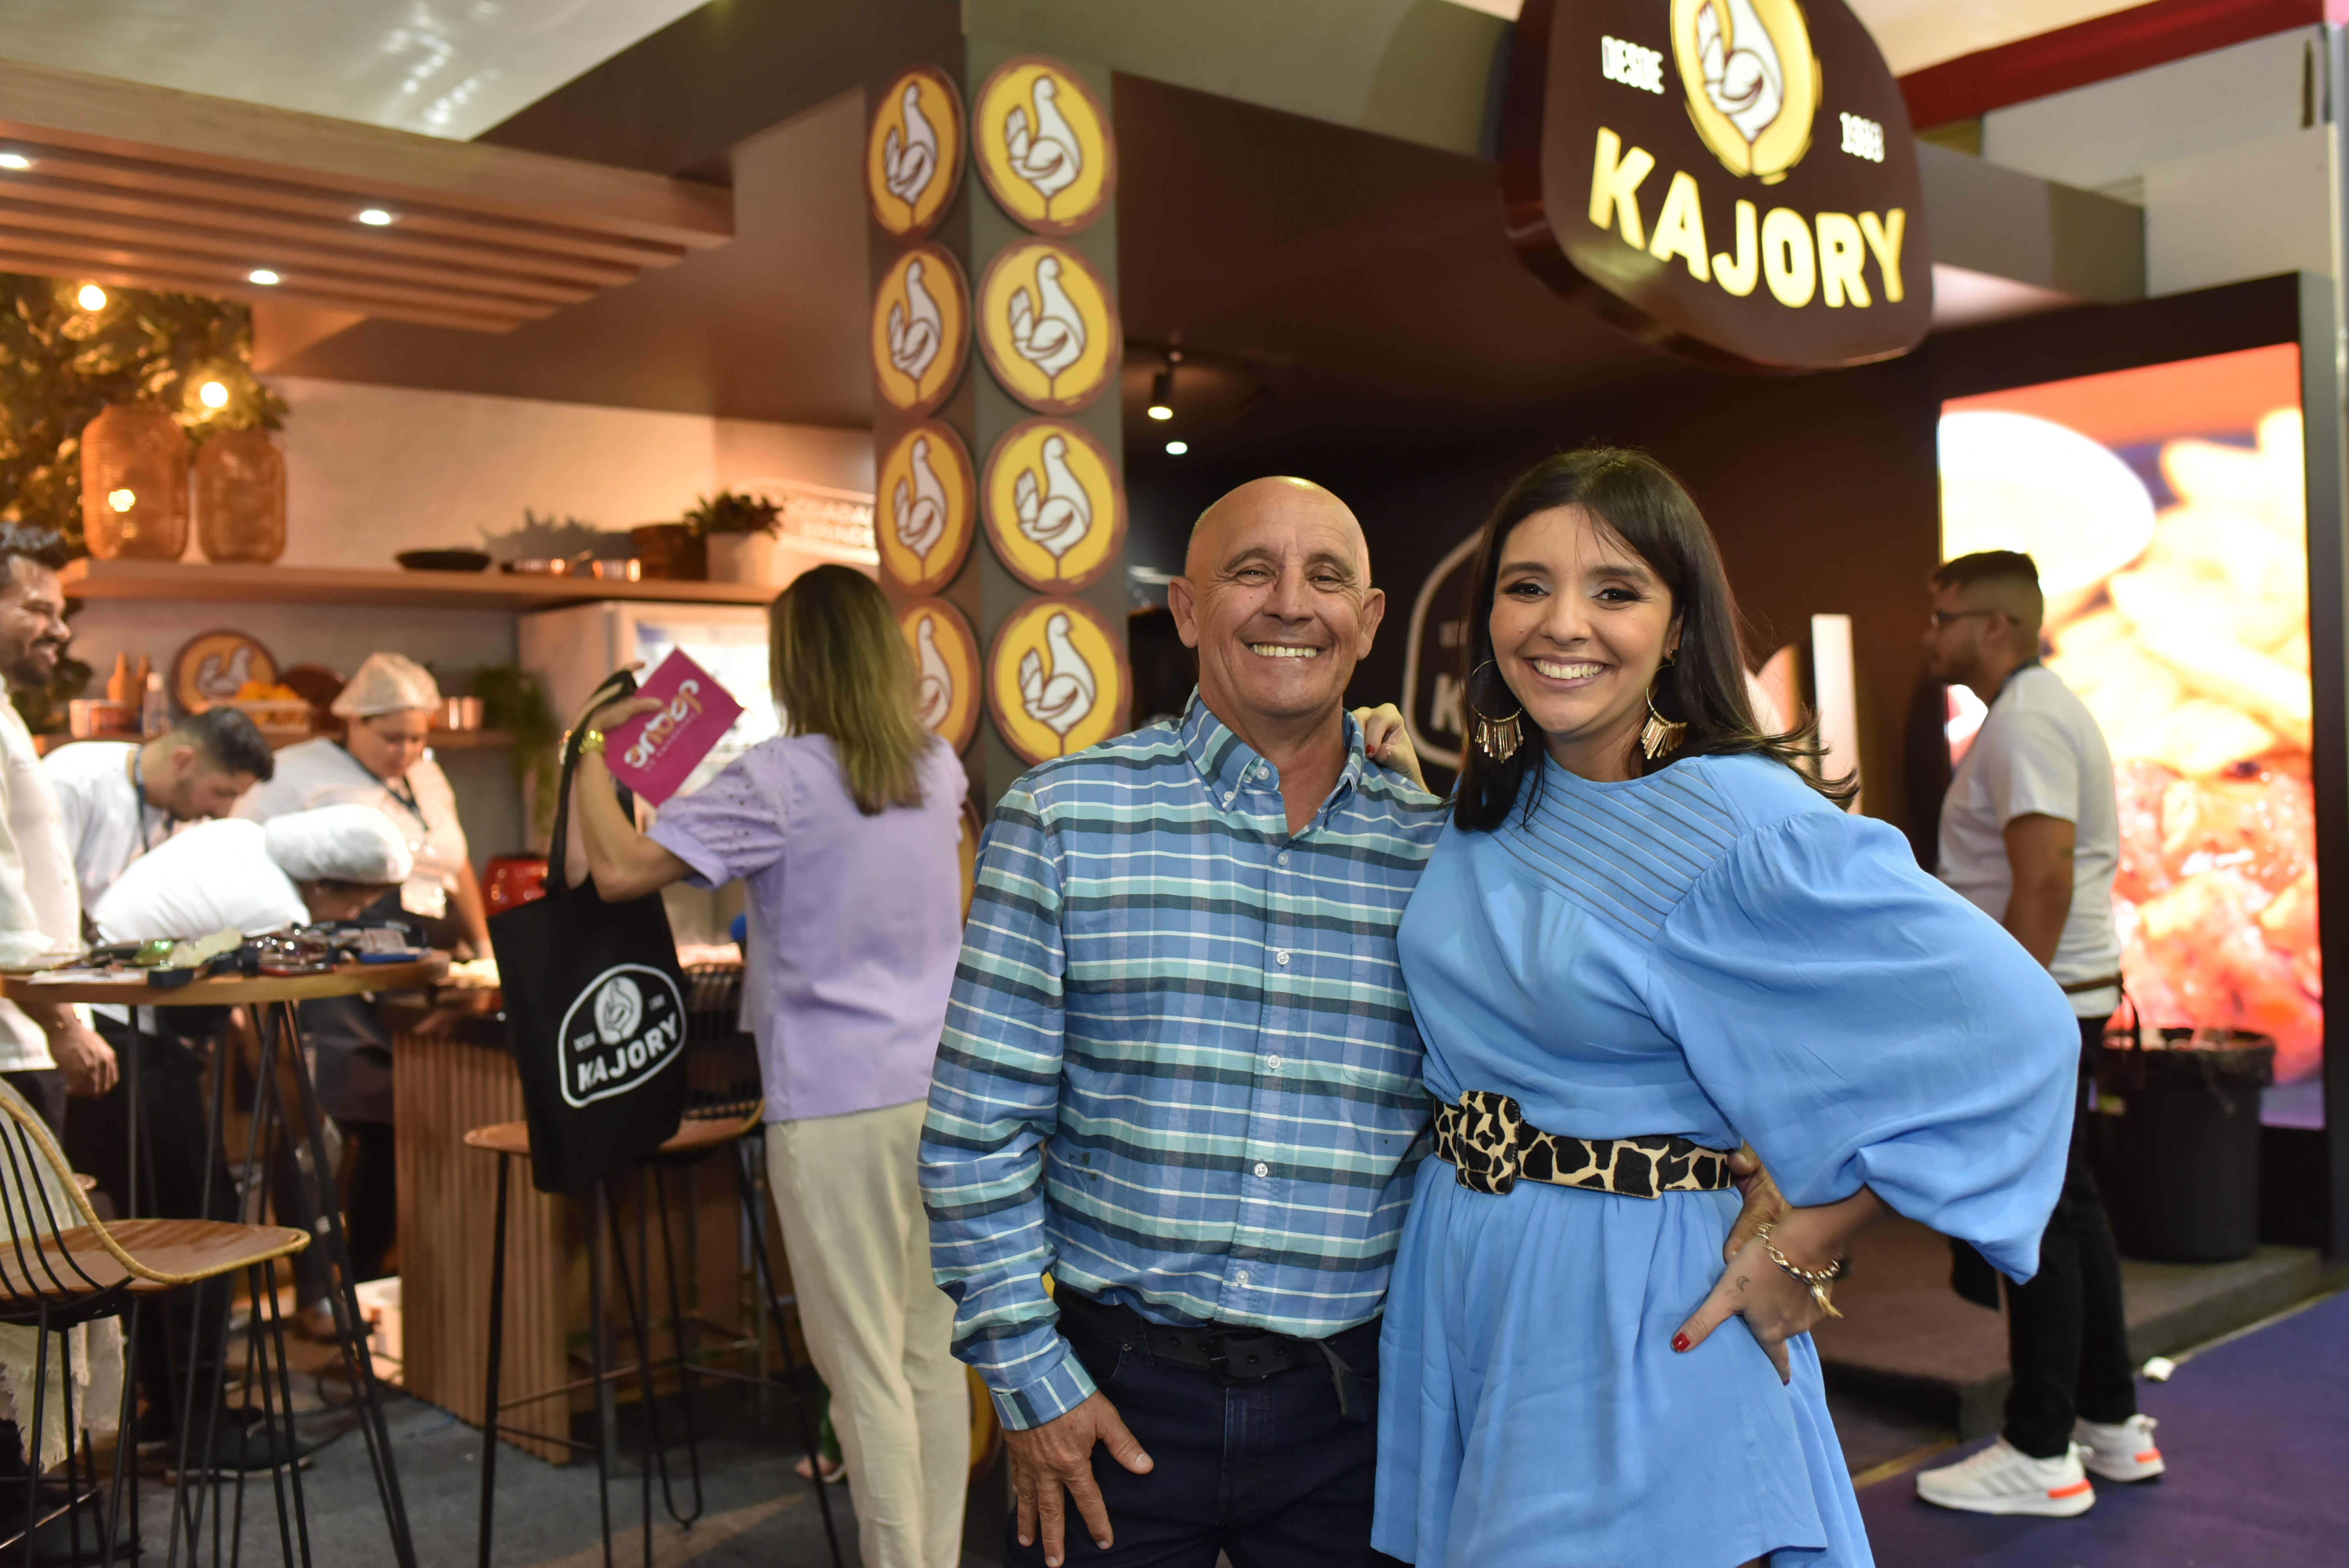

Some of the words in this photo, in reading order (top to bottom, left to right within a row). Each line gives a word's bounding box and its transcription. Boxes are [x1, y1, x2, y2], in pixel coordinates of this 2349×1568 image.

[1602, 35, 1664, 94] DESDE
[1589, 126, 1905, 308] KAJORY
[577, 1012, 679, 1093] KAJORY
